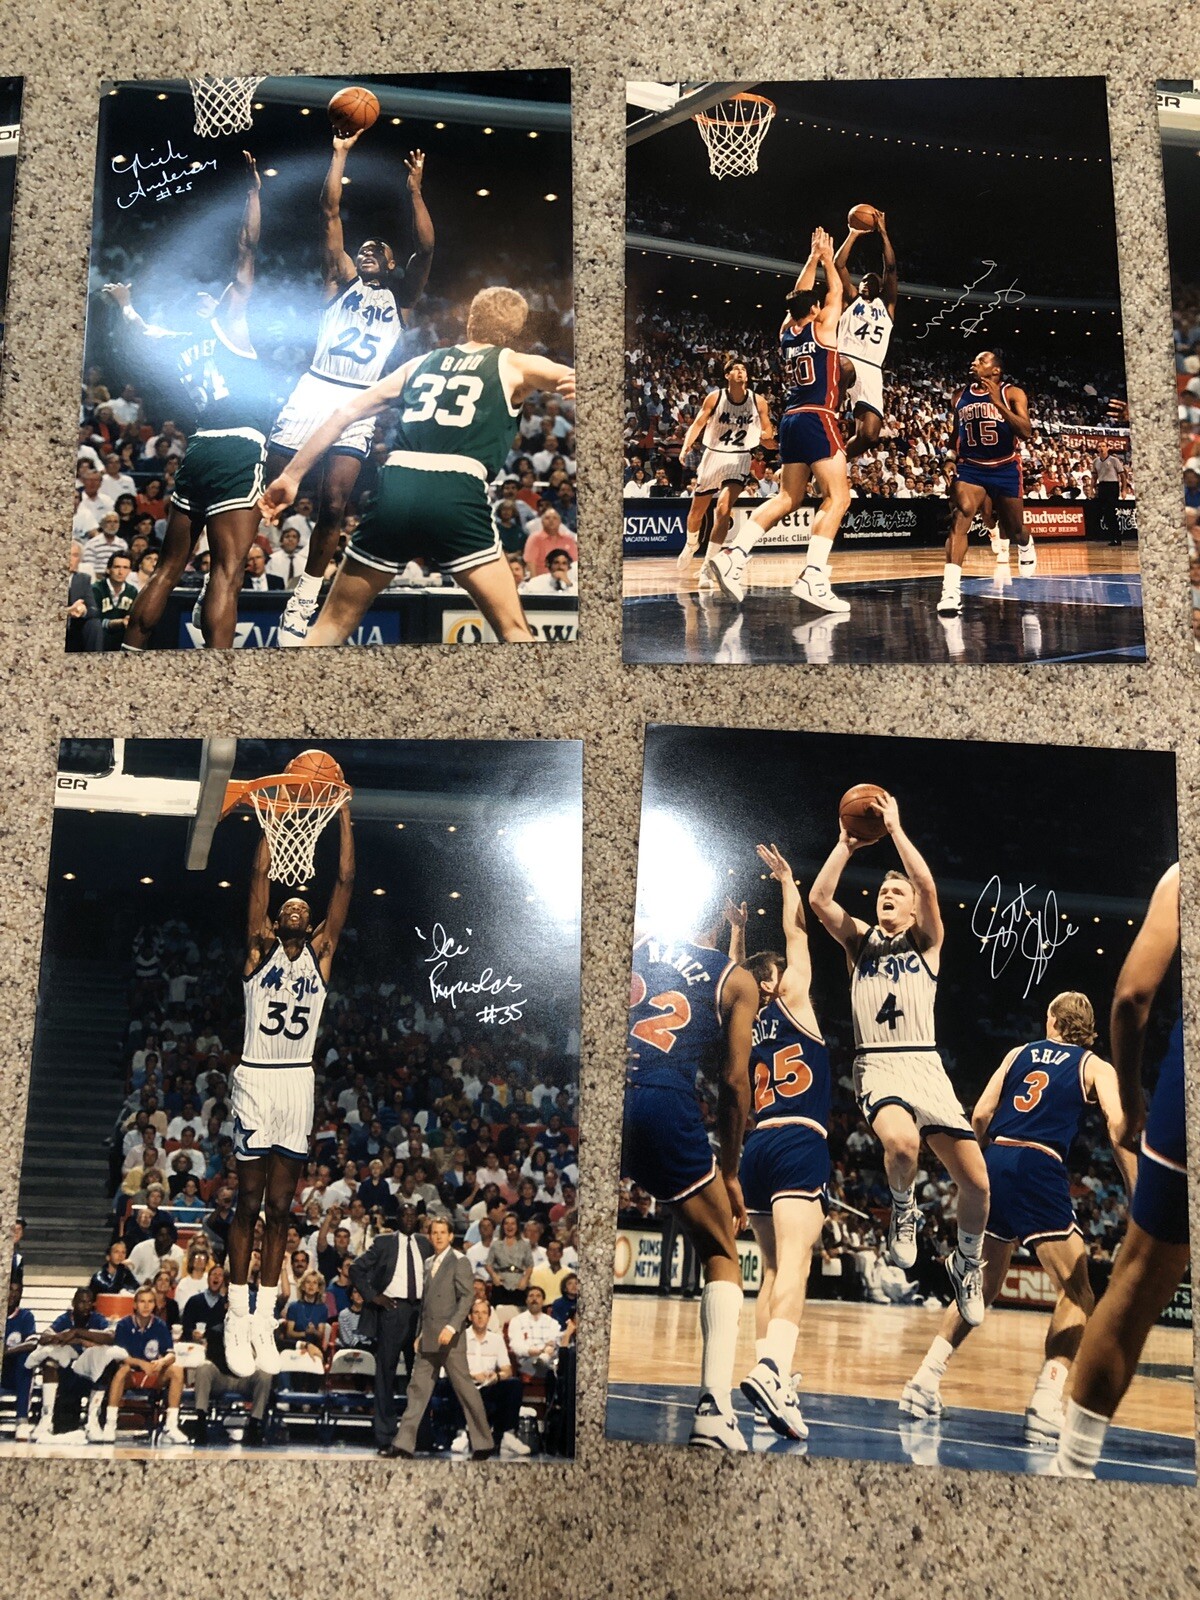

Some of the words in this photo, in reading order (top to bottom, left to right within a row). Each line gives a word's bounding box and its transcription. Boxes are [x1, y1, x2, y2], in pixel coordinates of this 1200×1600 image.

[156, 182, 193, 201] #25
[328, 327, 381, 364] 25
[854, 323, 884, 344] 45
[440, 354, 484, 372] BIRD
[402, 373, 484, 428] 33
[719, 429, 747, 446] 42
[965, 421, 999, 446] 15
[1061, 434, 1127, 450] Budwiser
[1023, 510, 1083, 524] Budweiser
[792, 534, 812, 542] Clini
[647, 939, 711, 986] NANCE
[259, 1001, 311, 1041] 35
[475, 999, 528, 1025] #35
[875, 992, 904, 1030] 4
[754, 1043, 813, 1115] 25
[1013, 1070, 1049, 1112] 3
